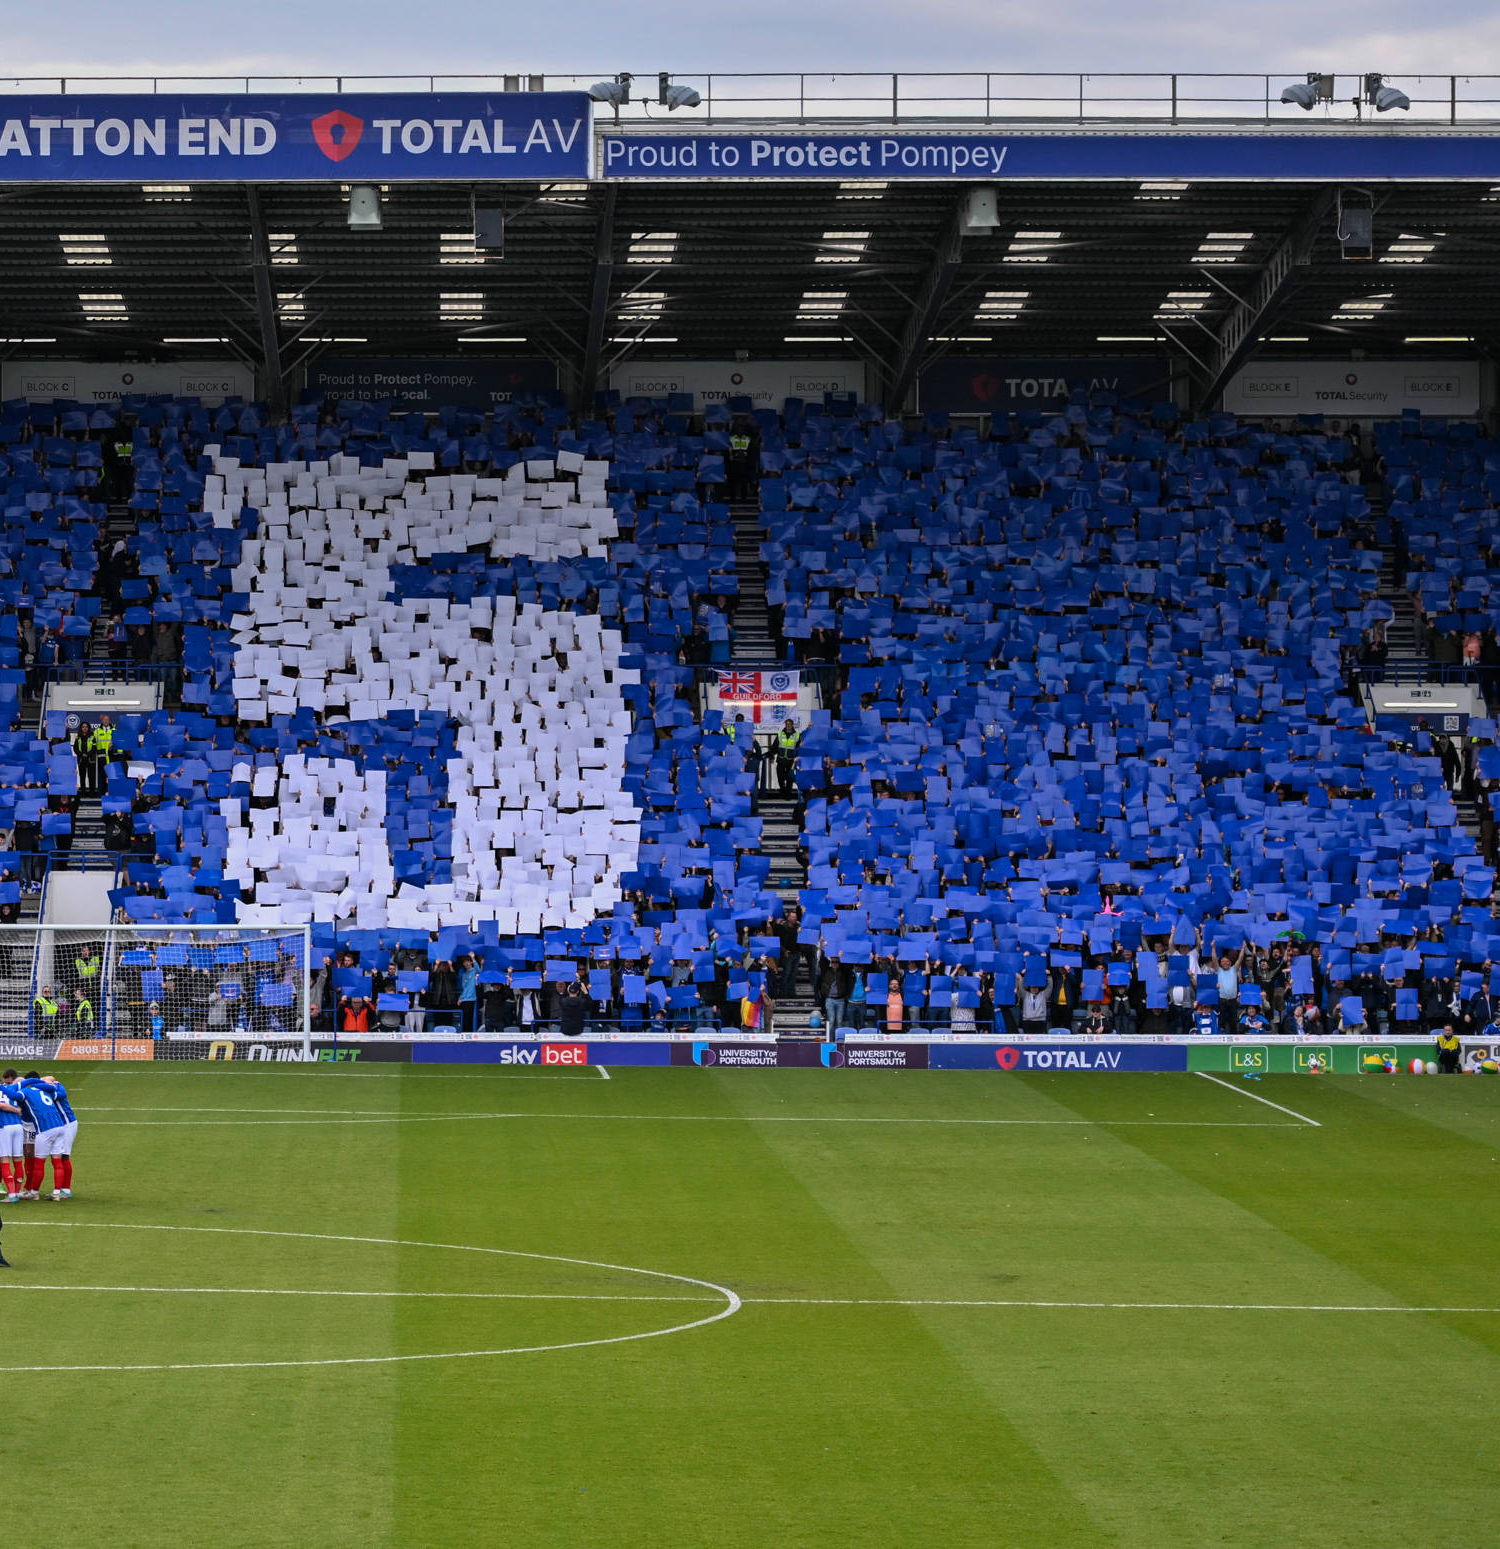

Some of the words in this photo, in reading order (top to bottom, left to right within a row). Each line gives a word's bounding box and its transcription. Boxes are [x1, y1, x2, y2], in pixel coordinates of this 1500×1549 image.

[178, 118, 277, 156] END
[373, 119, 516, 154] TOTAL
[523, 119, 582, 154] AV
[606, 140, 697, 167] Proud
[709, 142, 740, 167] to
[751, 140, 871, 167] Protect
[881, 140, 1008, 173] Pompey
[319, 373, 354, 385] Proud
[358, 374, 370, 385] to
[374, 373, 421, 385] Protect
[27, 382, 59, 392] BLOCK
[61, 382, 69, 392] C
[186, 382, 219, 392] BLOCK
[221, 382, 229, 392] C
[635, 382, 668, 392] BLOCK
[670, 382, 678, 392] D
[796, 382, 829, 392] BLOCK
[831, 382, 839, 392] D
[1004, 378, 1069, 398] TOTA
[1249, 383, 1281, 392] BLOCK
[1284, 383, 1291, 392] E
[1411, 383, 1443, 392] BLOCK
[1446, 383, 1452, 392] E
[358, 390, 370, 400] to
[1315, 391, 1348, 400] TOTAL
[732, 692, 782, 701] GUILDFORD
[500, 1045, 538, 1065] sky
[546, 1046, 582, 1064] bet
[719, 1049, 769, 1057] UNIVERSITY
[848, 1050, 898, 1058] UNIVERSITY
[719, 1057, 777, 1065] PORTSMOUTH
[848, 1058, 906, 1066] PORTSMOUTH
[1023, 1051, 1091, 1068] TOTAL
[1094, 1051, 1122, 1068] AV
[1235, 1053, 1262, 1066] L&S
